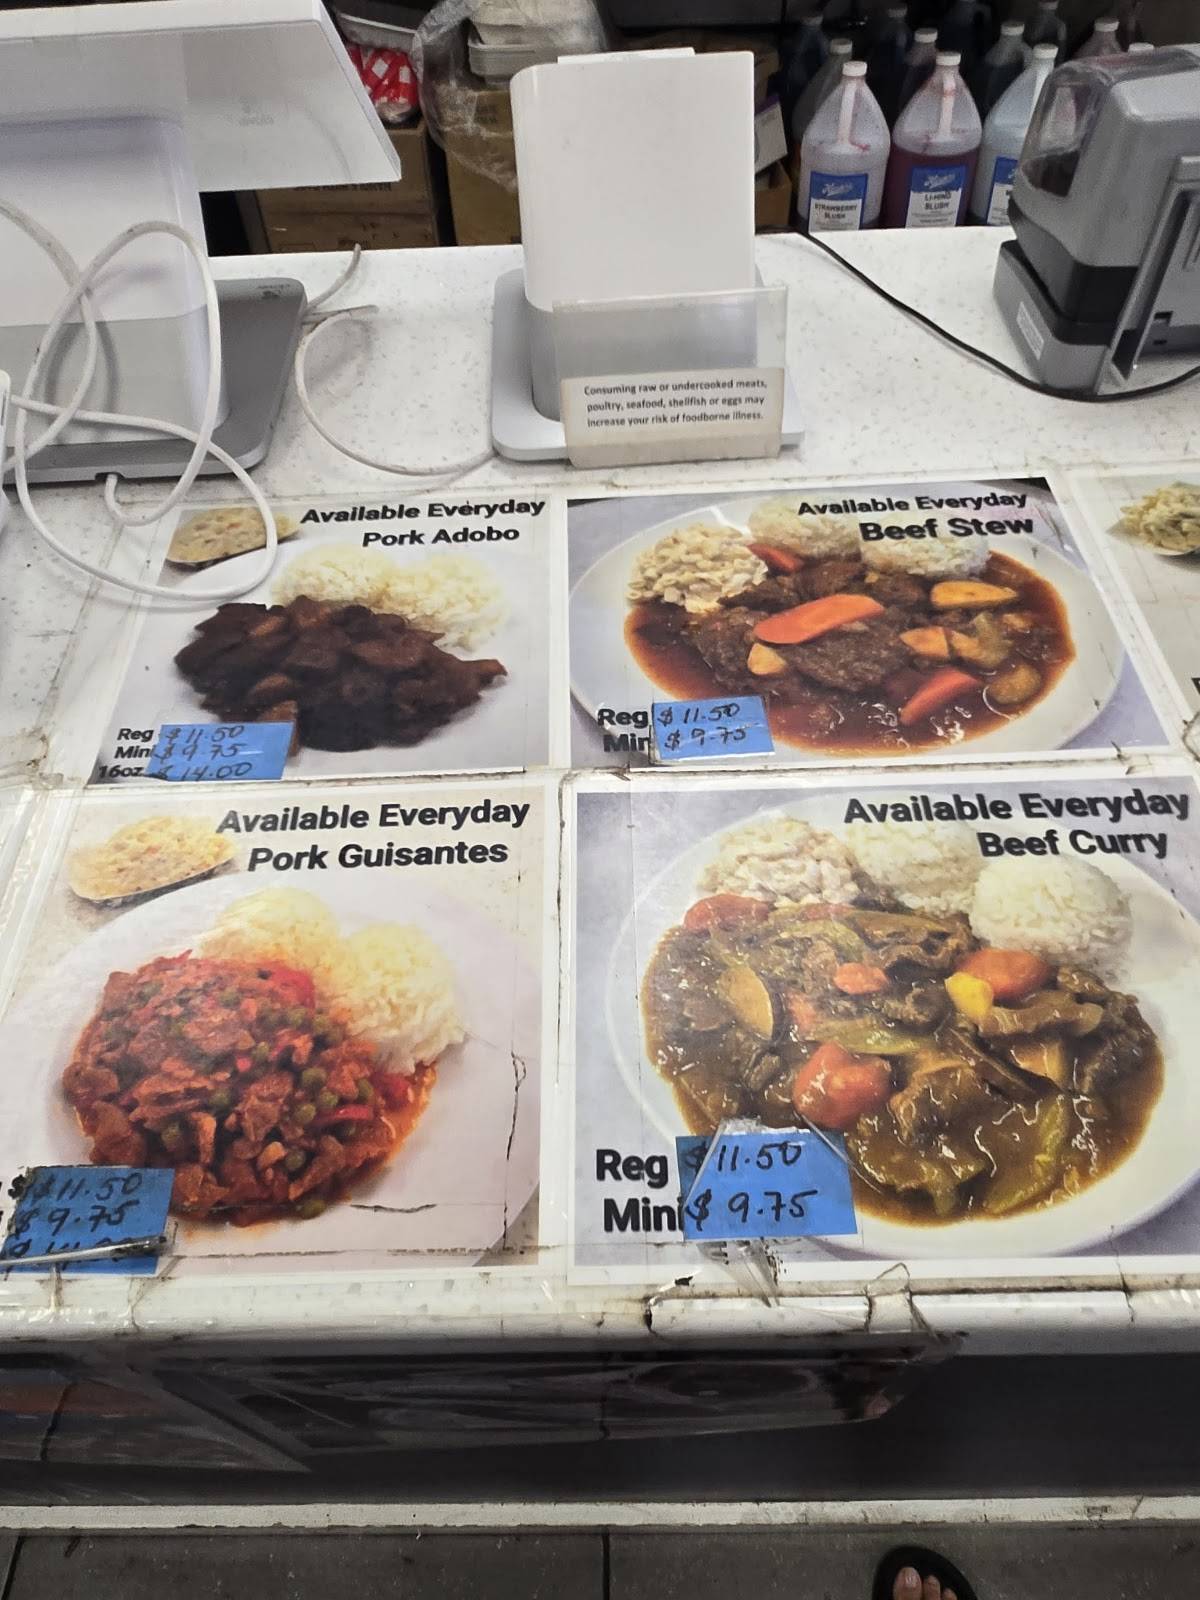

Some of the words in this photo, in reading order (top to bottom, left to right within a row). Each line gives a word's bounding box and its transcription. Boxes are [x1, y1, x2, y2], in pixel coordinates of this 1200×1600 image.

[584, 384, 636, 396] Consuming
[638, 384, 657, 393] raw
[659, 383, 670, 392] or
[671, 380, 734, 391] undercooked
[735, 379, 768, 389] meats,
[586, 402, 624, 413] poultry,
[626, 399, 667, 410] seafood,
[668, 396, 707, 408] shellfish
[709, 397, 719, 405] or
[721, 396, 743, 406] eggs
[744, 396, 764, 405] may
[587, 416, 626, 428] increase
[628, 417, 649, 427] your
[651, 414, 668, 425] risk
[670, 413, 680, 424] of
[682, 412, 731, 423] foodborne
[732, 411, 763, 421] illness.
[300, 503, 421, 524] Available
[427, 499, 546, 518] Everyday
[797, 496, 910, 516] Available
[914, 492, 1027, 511] Everyday
[362, 529, 425, 547] Pork
[431, 526, 520, 544] Adobo
[858, 518, 938, 541] Beef
[946, 518, 1034, 537] Stew
[594, 708, 649, 728] Reg
[117, 728, 154, 743] Reg
[603, 733, 650, 752] Min
[98, 764, 145, 778] 16oz
[216, 804, 370, 833] Available
[379, 799, 530, 830] Everyday
[844, 794, 1013, 824] Available
[1018, 788, 1190, 823] Everyday
[977, 829, 1060, 858] Beef
[1069, 829, 1168, 859] Curry
[247, 845, 328, 872] Pork
[338, 842, 509, 868] Guisantes
[596, 1149, 668, 1189] Reg
